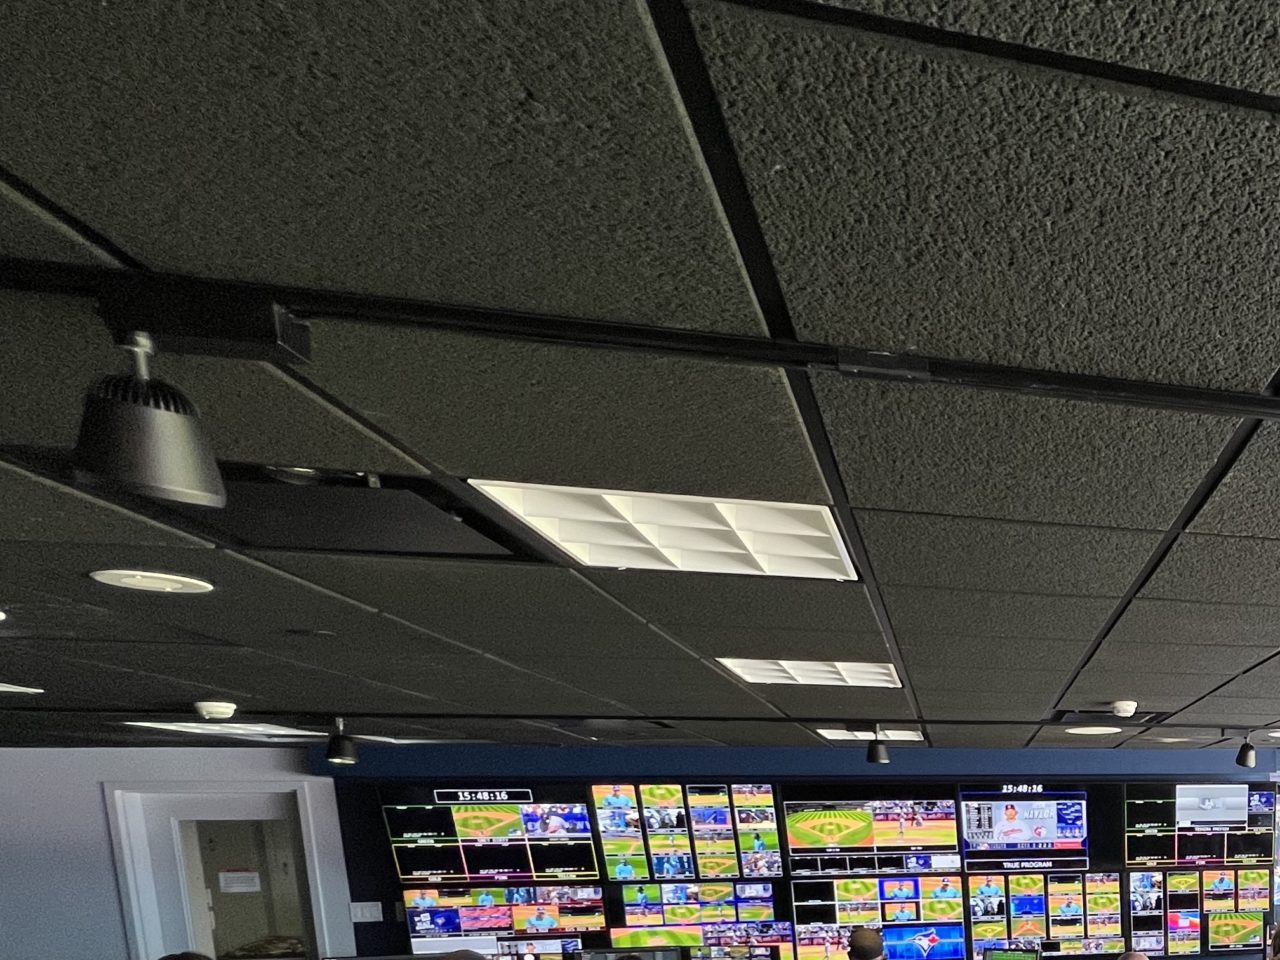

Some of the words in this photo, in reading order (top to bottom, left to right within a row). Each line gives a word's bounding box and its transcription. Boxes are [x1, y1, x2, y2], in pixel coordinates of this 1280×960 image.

[1002, 785, 1043, 793] 15:48:16
[457, 791, 509, 801] 15:48:16
[1021, 861, 1053, 869] PROGRAM
